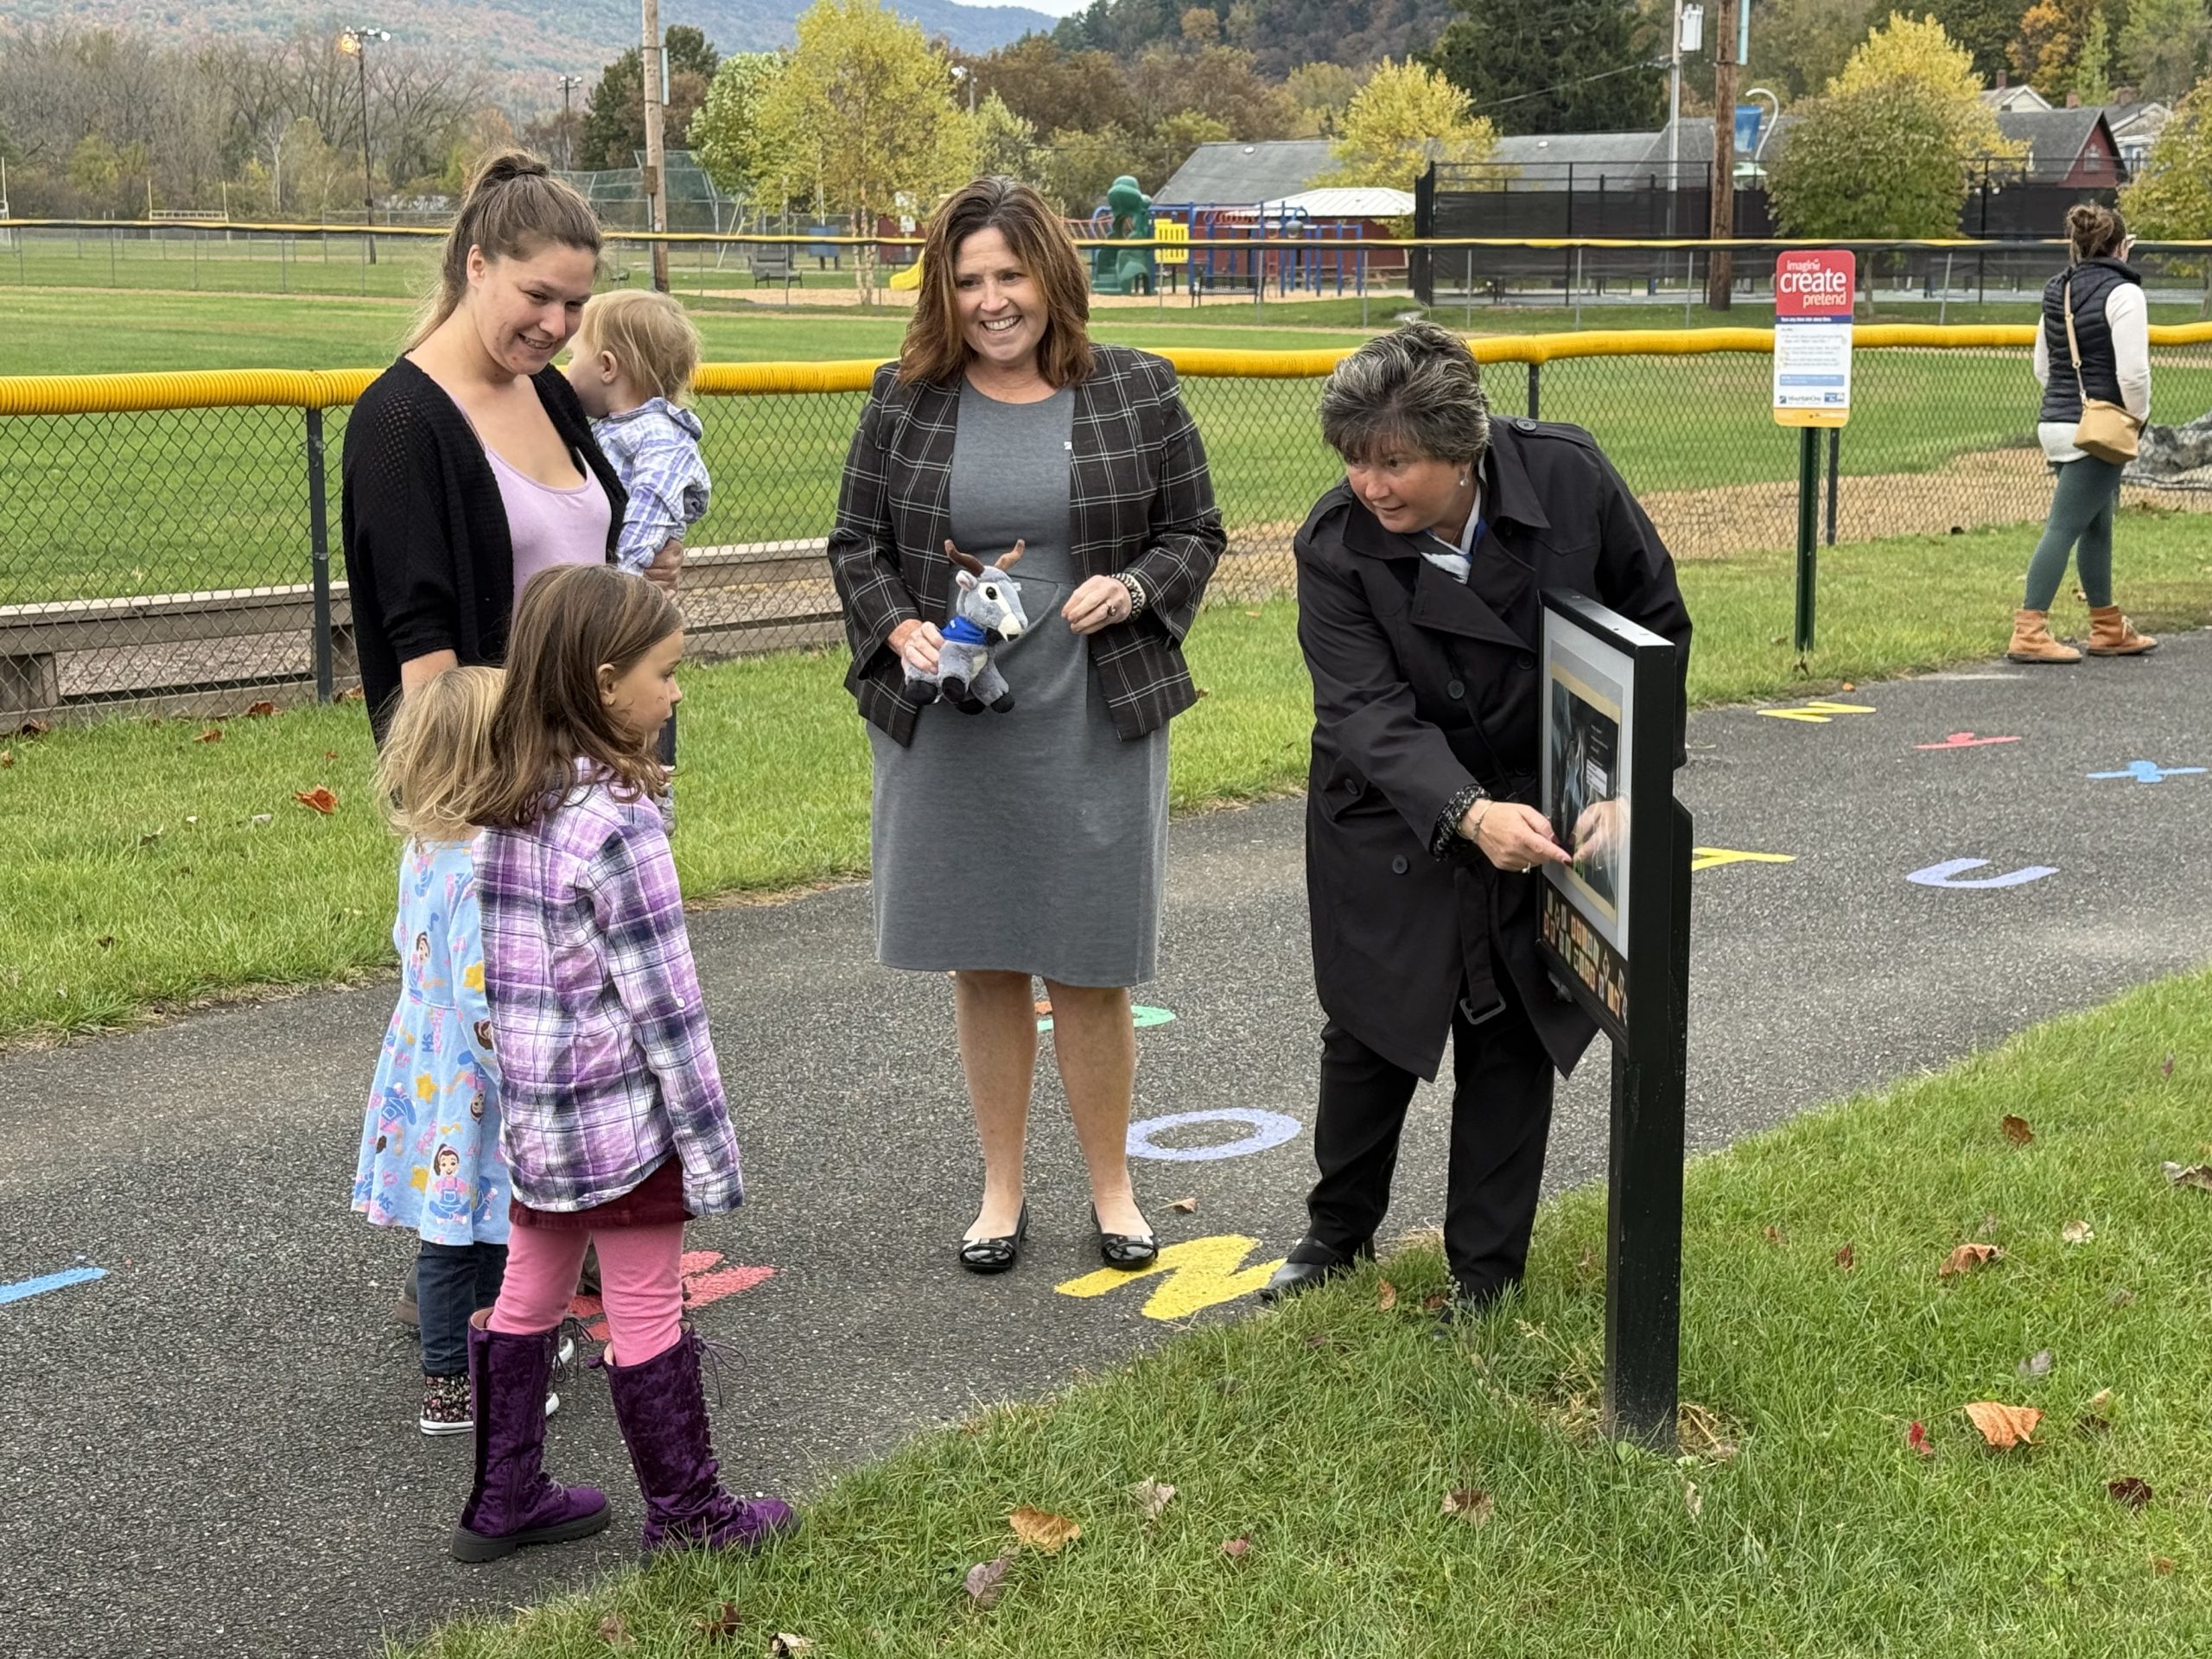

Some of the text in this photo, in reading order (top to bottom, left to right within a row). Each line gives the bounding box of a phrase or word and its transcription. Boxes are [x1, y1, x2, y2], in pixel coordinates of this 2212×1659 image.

[1780, 268, 1847, 294] create
[1802, 290, 1847, 309] pretend
[1126, 1107, 1303, 1161] O
